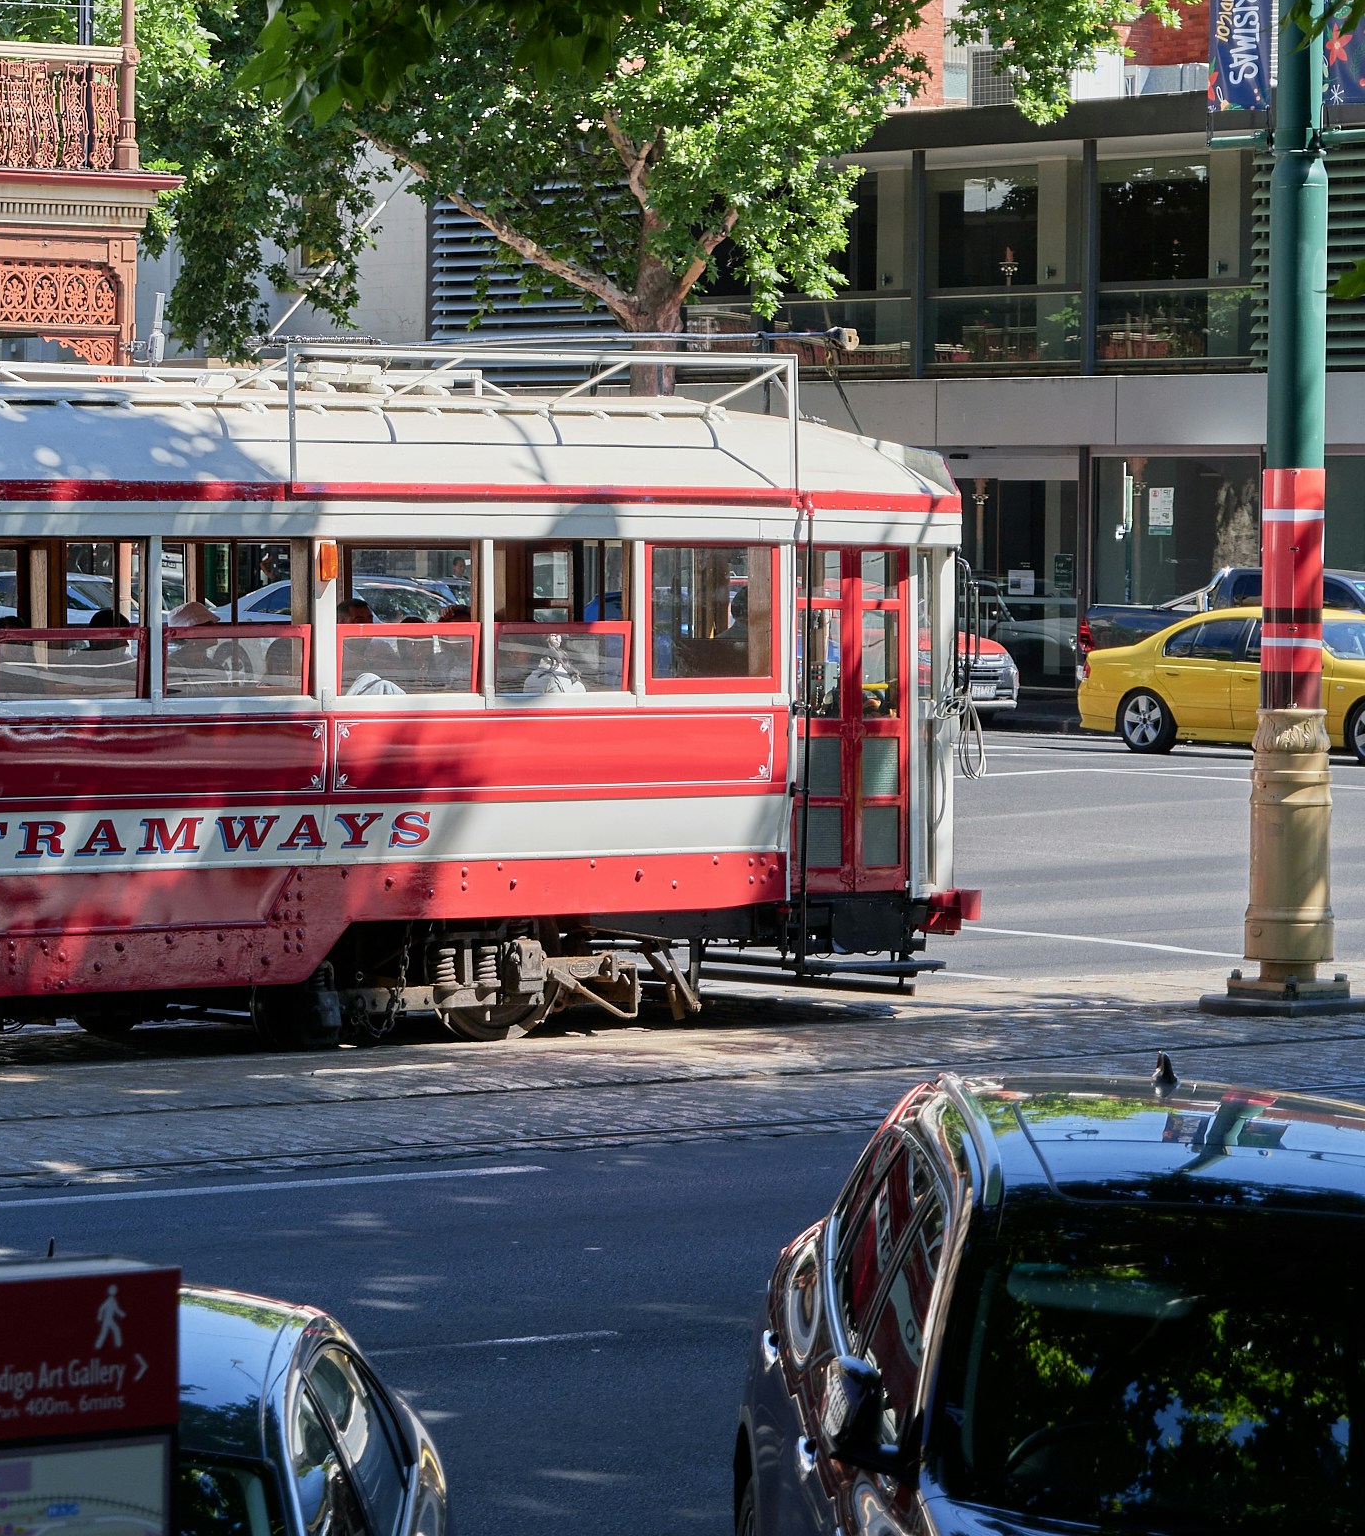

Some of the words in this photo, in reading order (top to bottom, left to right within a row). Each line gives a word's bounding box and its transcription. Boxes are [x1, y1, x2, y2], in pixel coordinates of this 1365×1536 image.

[37, 1362, 65, 1388] Art
[68, 1358, 126, 1392] Gallery
[78, 1393, 126, 1412] 6mins
